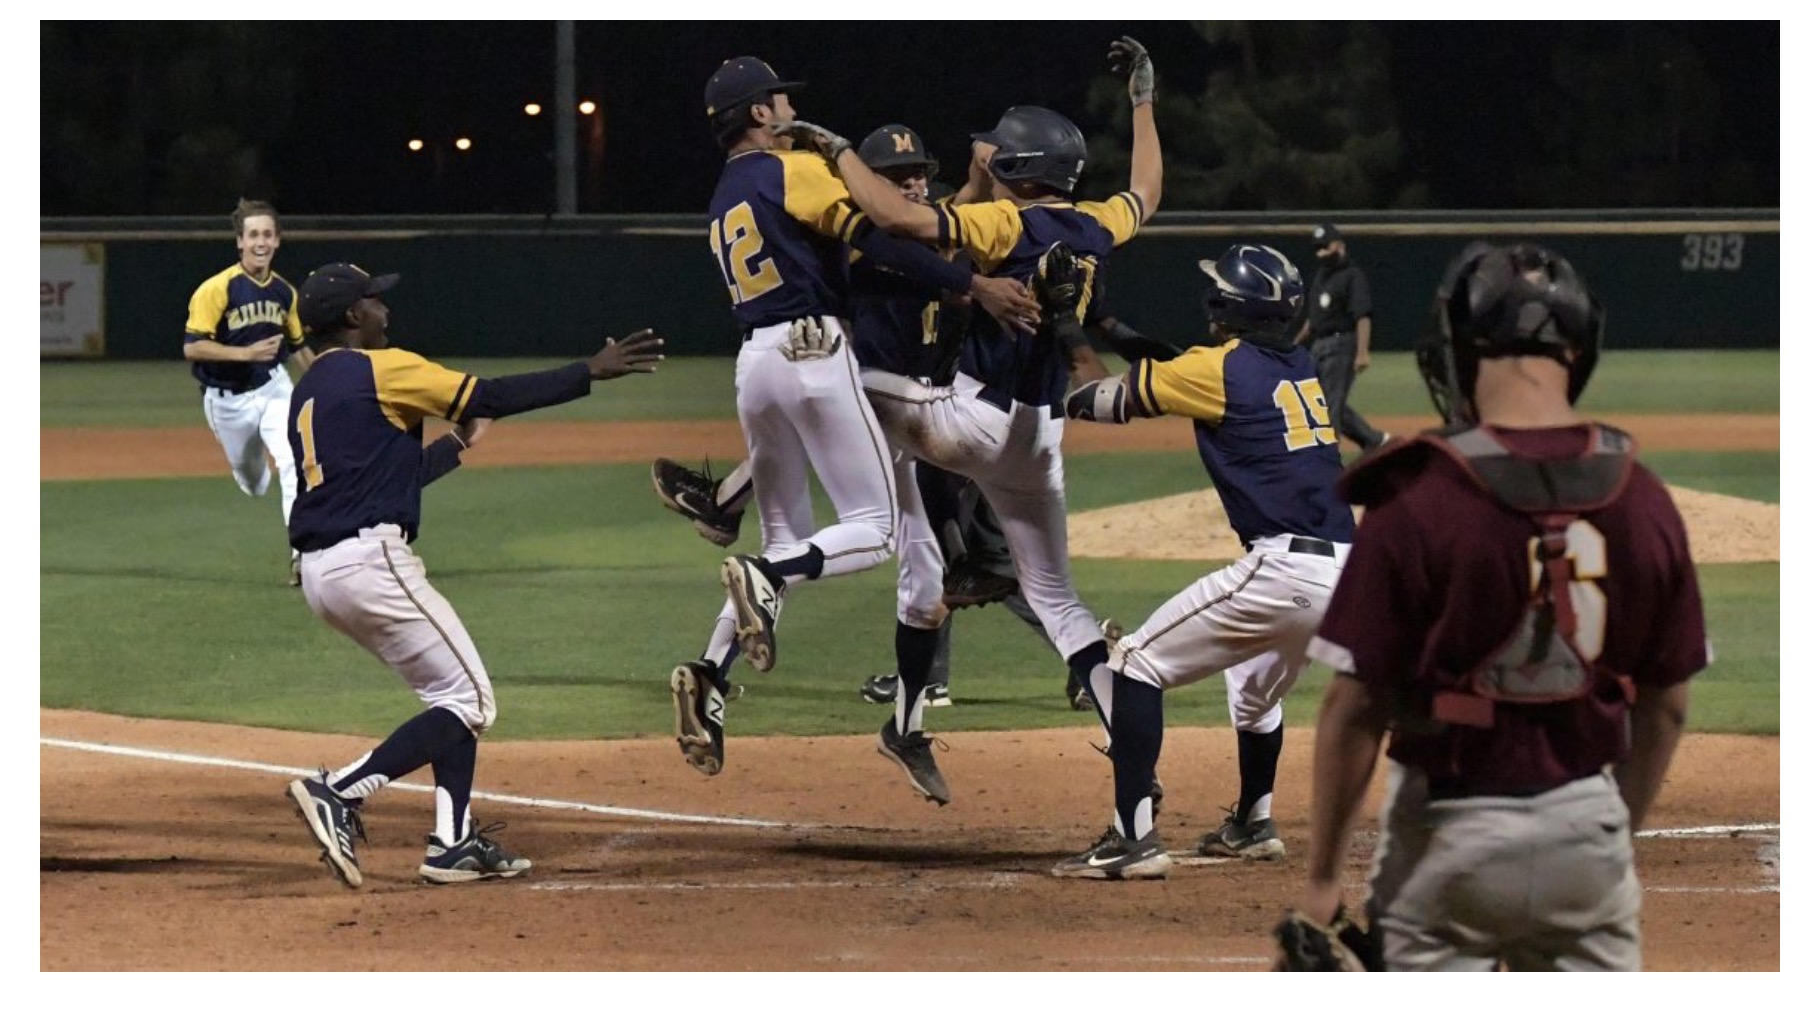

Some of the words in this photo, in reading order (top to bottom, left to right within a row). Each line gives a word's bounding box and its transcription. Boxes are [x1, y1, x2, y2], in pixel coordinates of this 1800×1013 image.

[892, 133, 915, 153] M
[709, 201, 784, 305] 12
[1681, 233, 1744, 271] 393
[297, 397, 324, 492] 1
